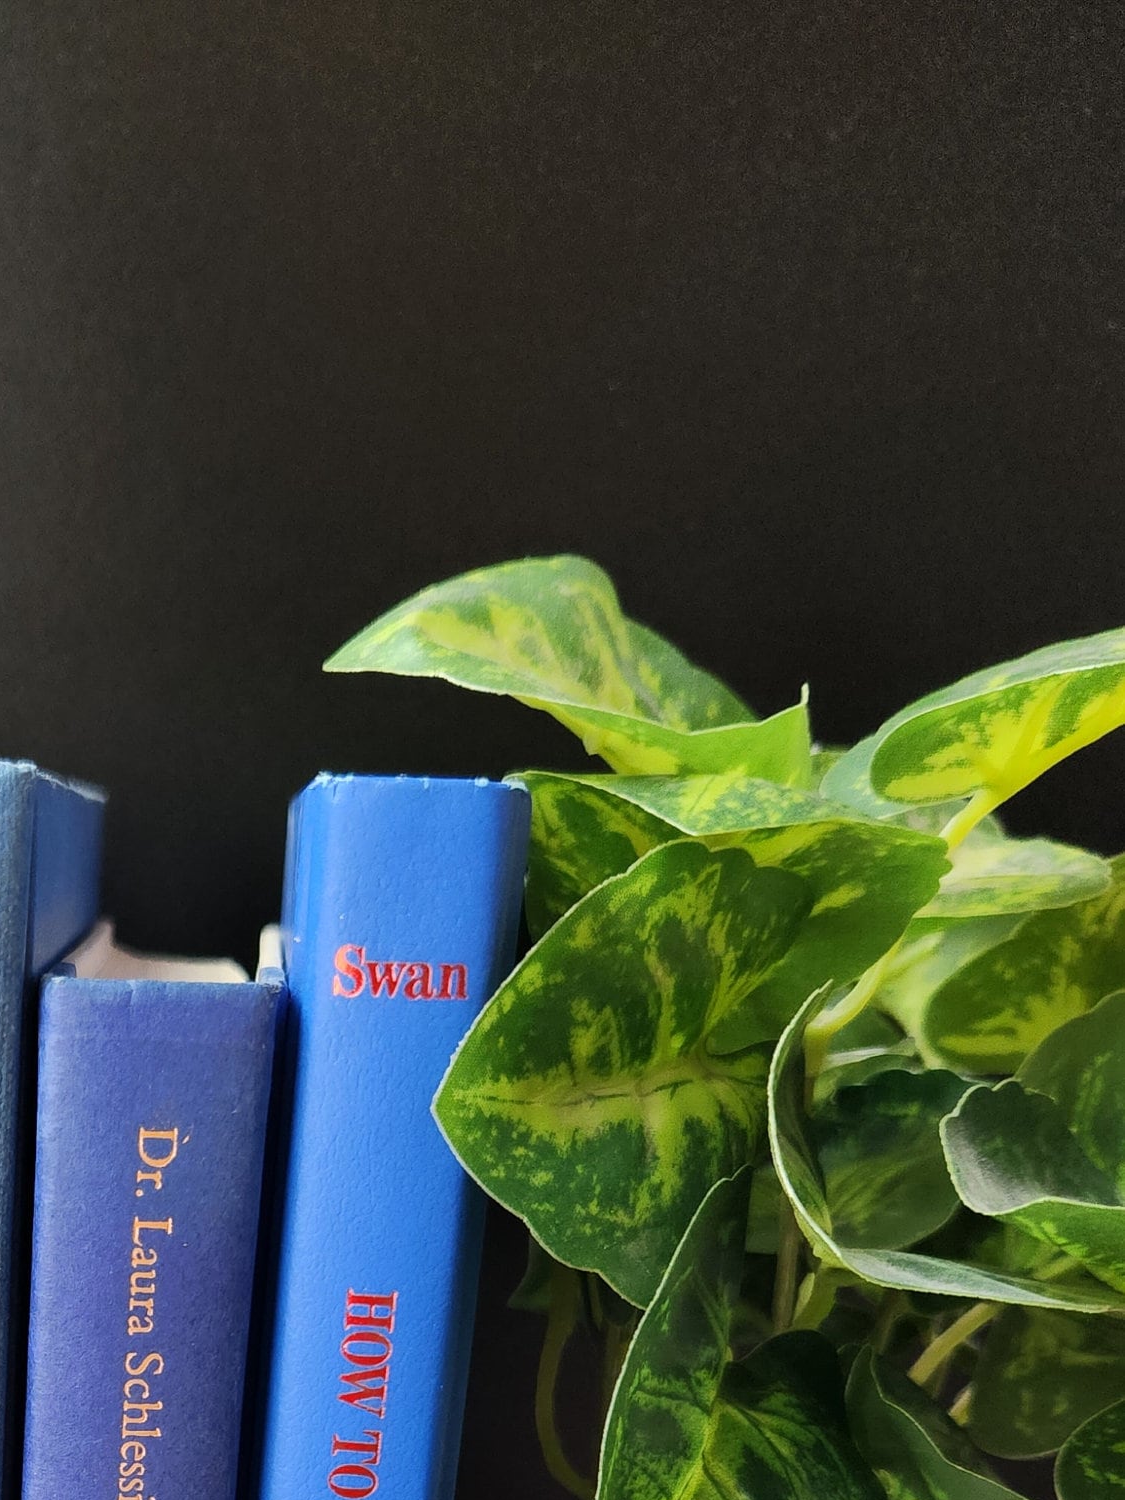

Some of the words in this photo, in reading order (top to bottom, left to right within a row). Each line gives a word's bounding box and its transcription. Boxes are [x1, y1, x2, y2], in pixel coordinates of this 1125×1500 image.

[333, 945, 469, 1001] Swan
[134, 1126, 177, 1198] Dr.
[128, 1217, 174, 1336] Laura
[338, 1289, 398, 1418] HOW
[328, 1431, 383, 1500] TO
